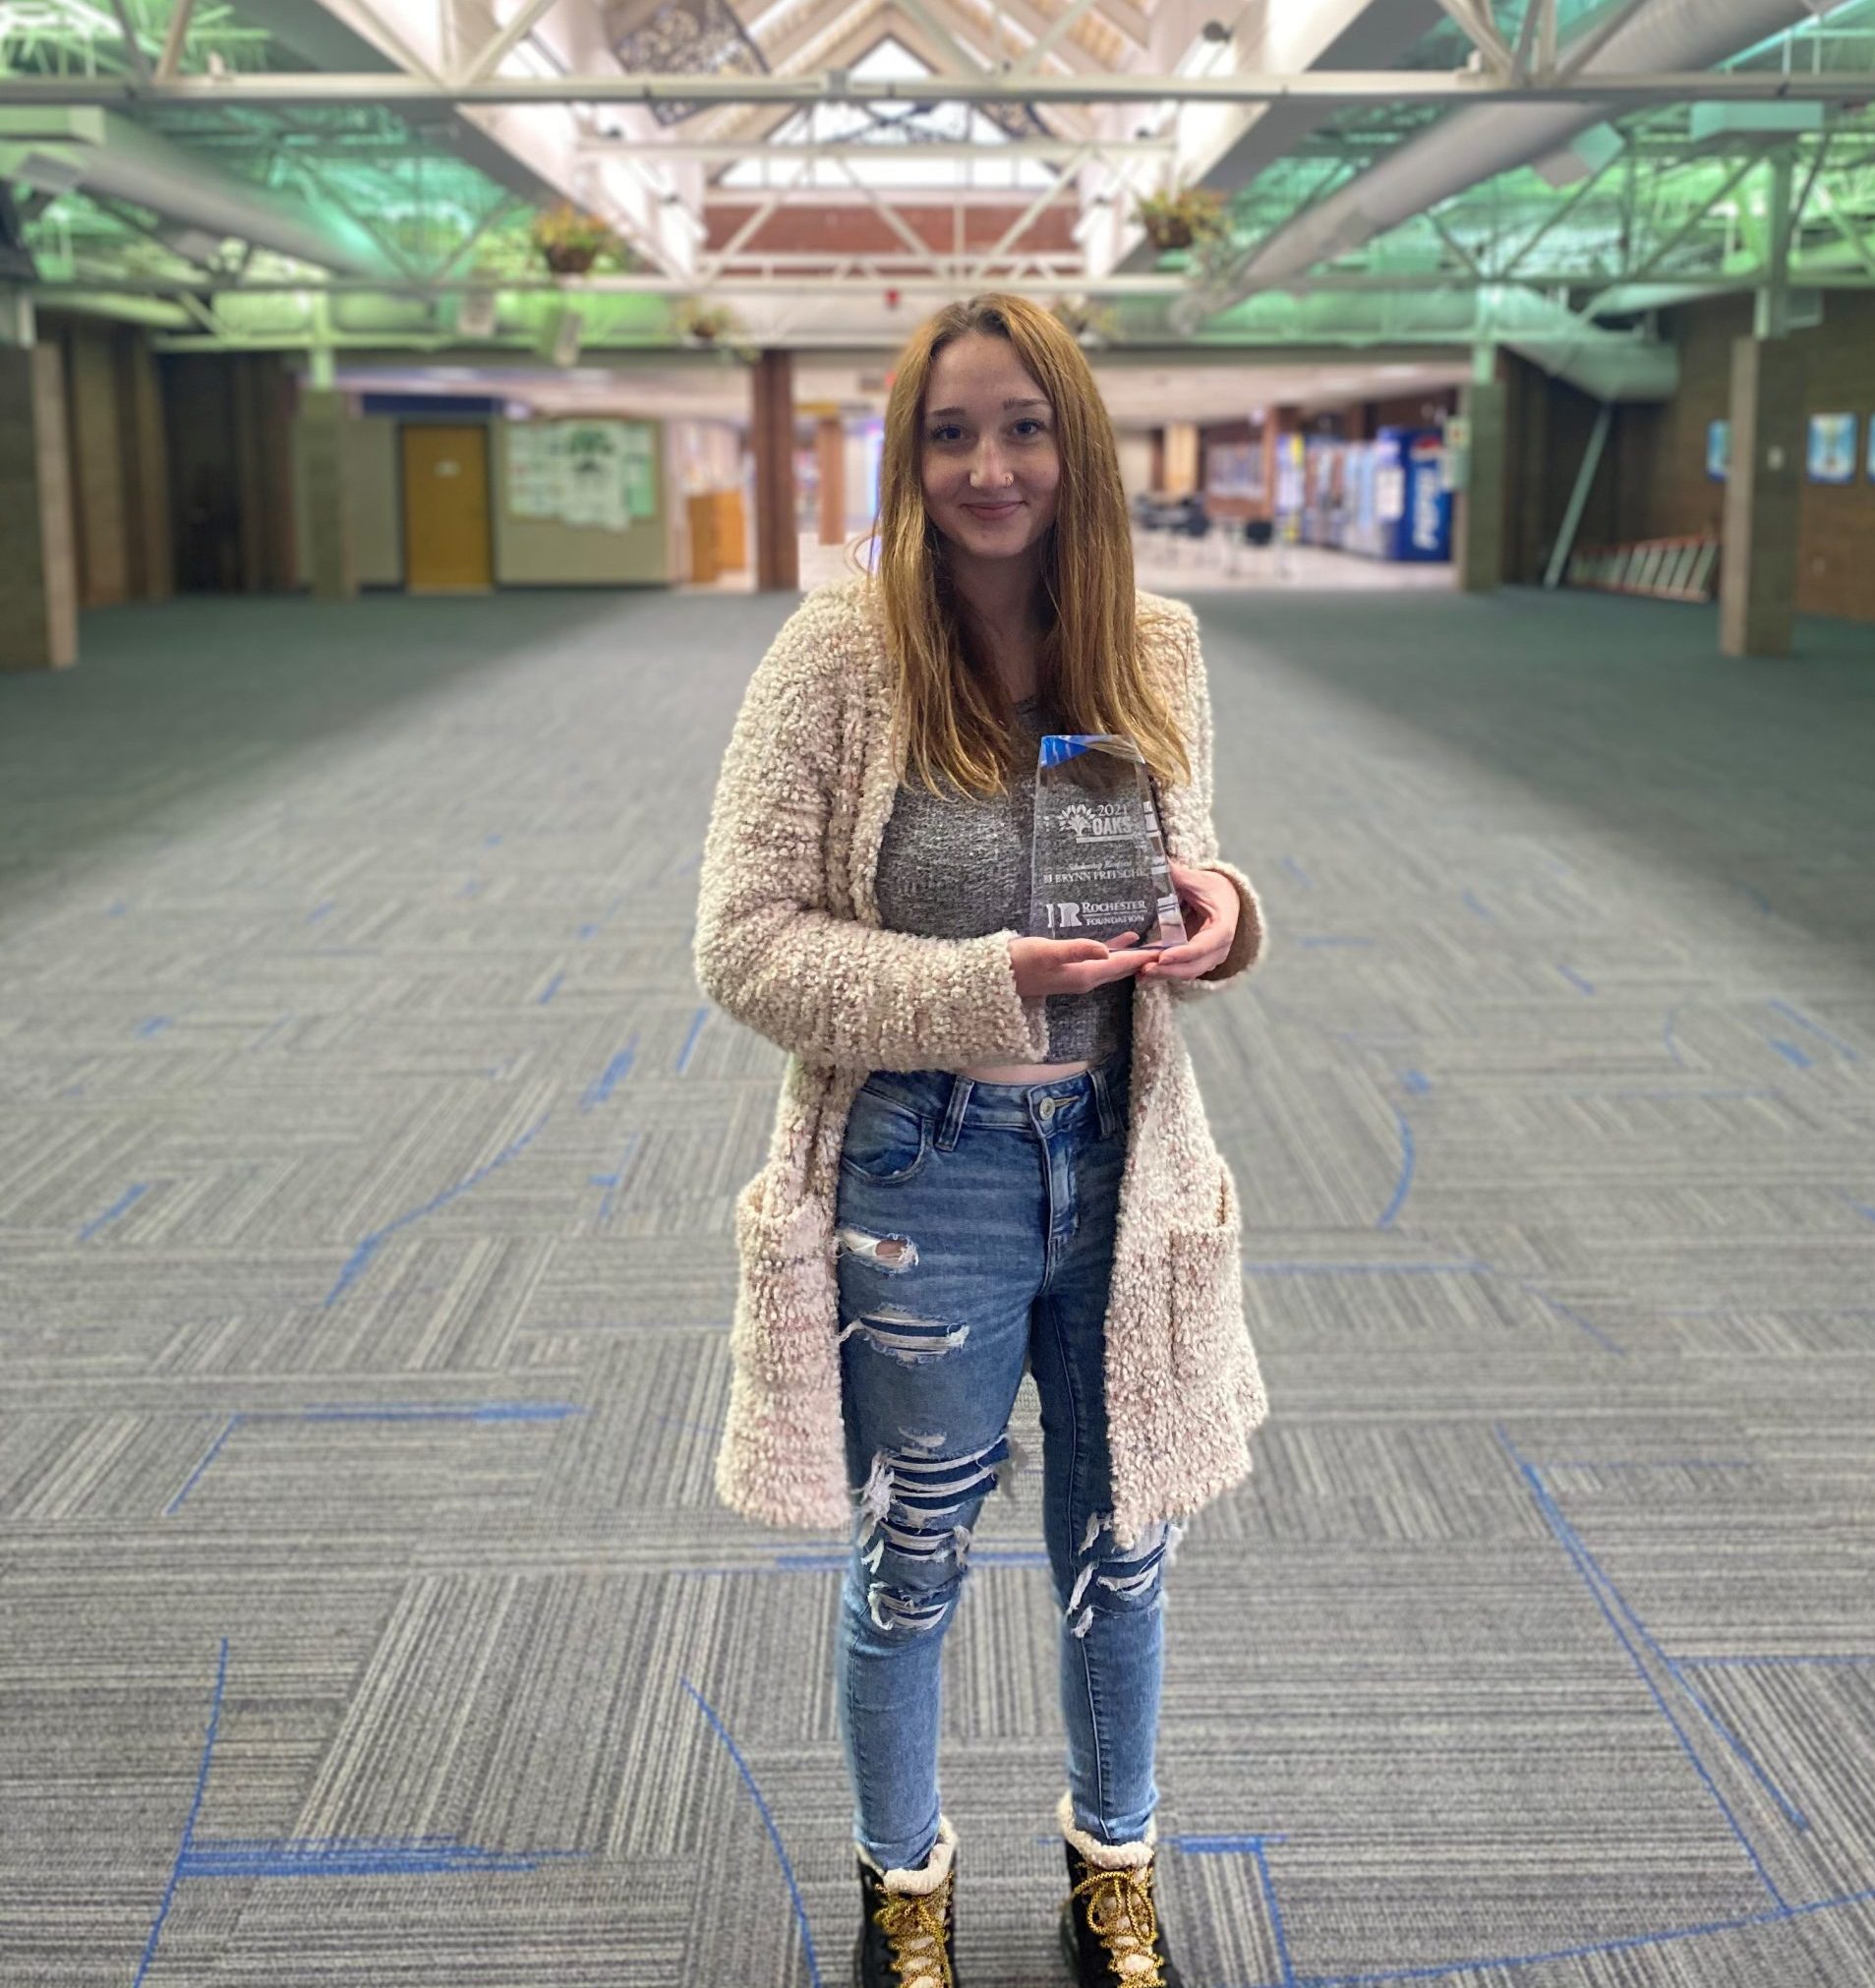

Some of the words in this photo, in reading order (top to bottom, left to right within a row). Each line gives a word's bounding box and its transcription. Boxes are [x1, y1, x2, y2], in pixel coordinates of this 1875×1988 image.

[1097, 803, 1128, 817] 2021
[1092, 816, 1133, 836] OAKS
[1086, 915, 1144, 926] FOUNDATION
